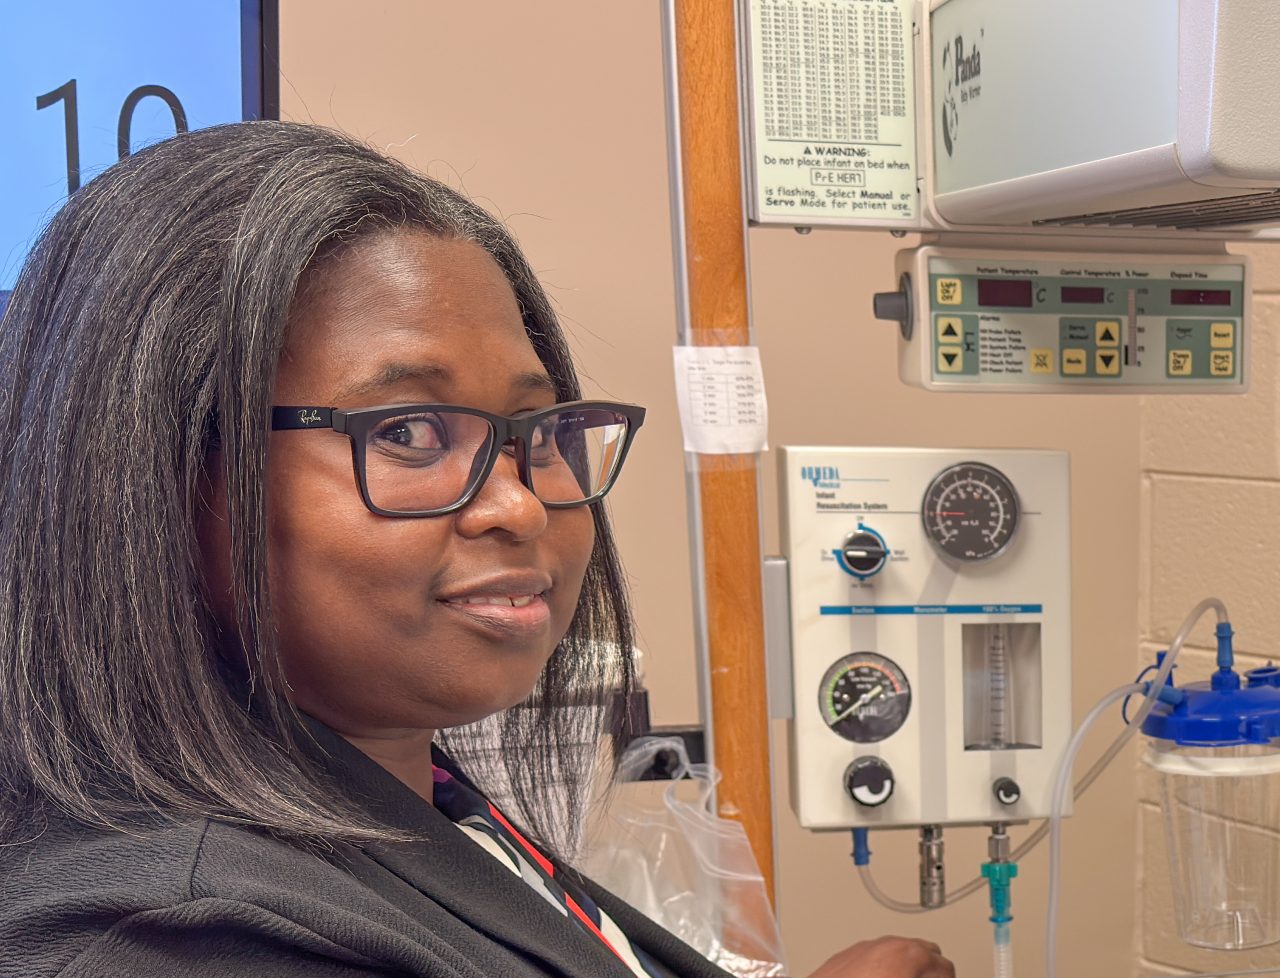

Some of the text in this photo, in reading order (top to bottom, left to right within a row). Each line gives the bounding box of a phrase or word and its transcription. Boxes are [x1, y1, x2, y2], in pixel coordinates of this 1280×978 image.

[955, 35, 981, 86] Panda
[815, 146, 870, 157] WARNING:
[764, 156, 910, 170] Do not place infant on bed when
[766, 187, 910, 200] is flashing. Select Manual or
[766, 197, 911, 212] Servo Mode for patient use.
[1001, 267, 1039, 275] Temperature
[864, 502, 888, 511] System
